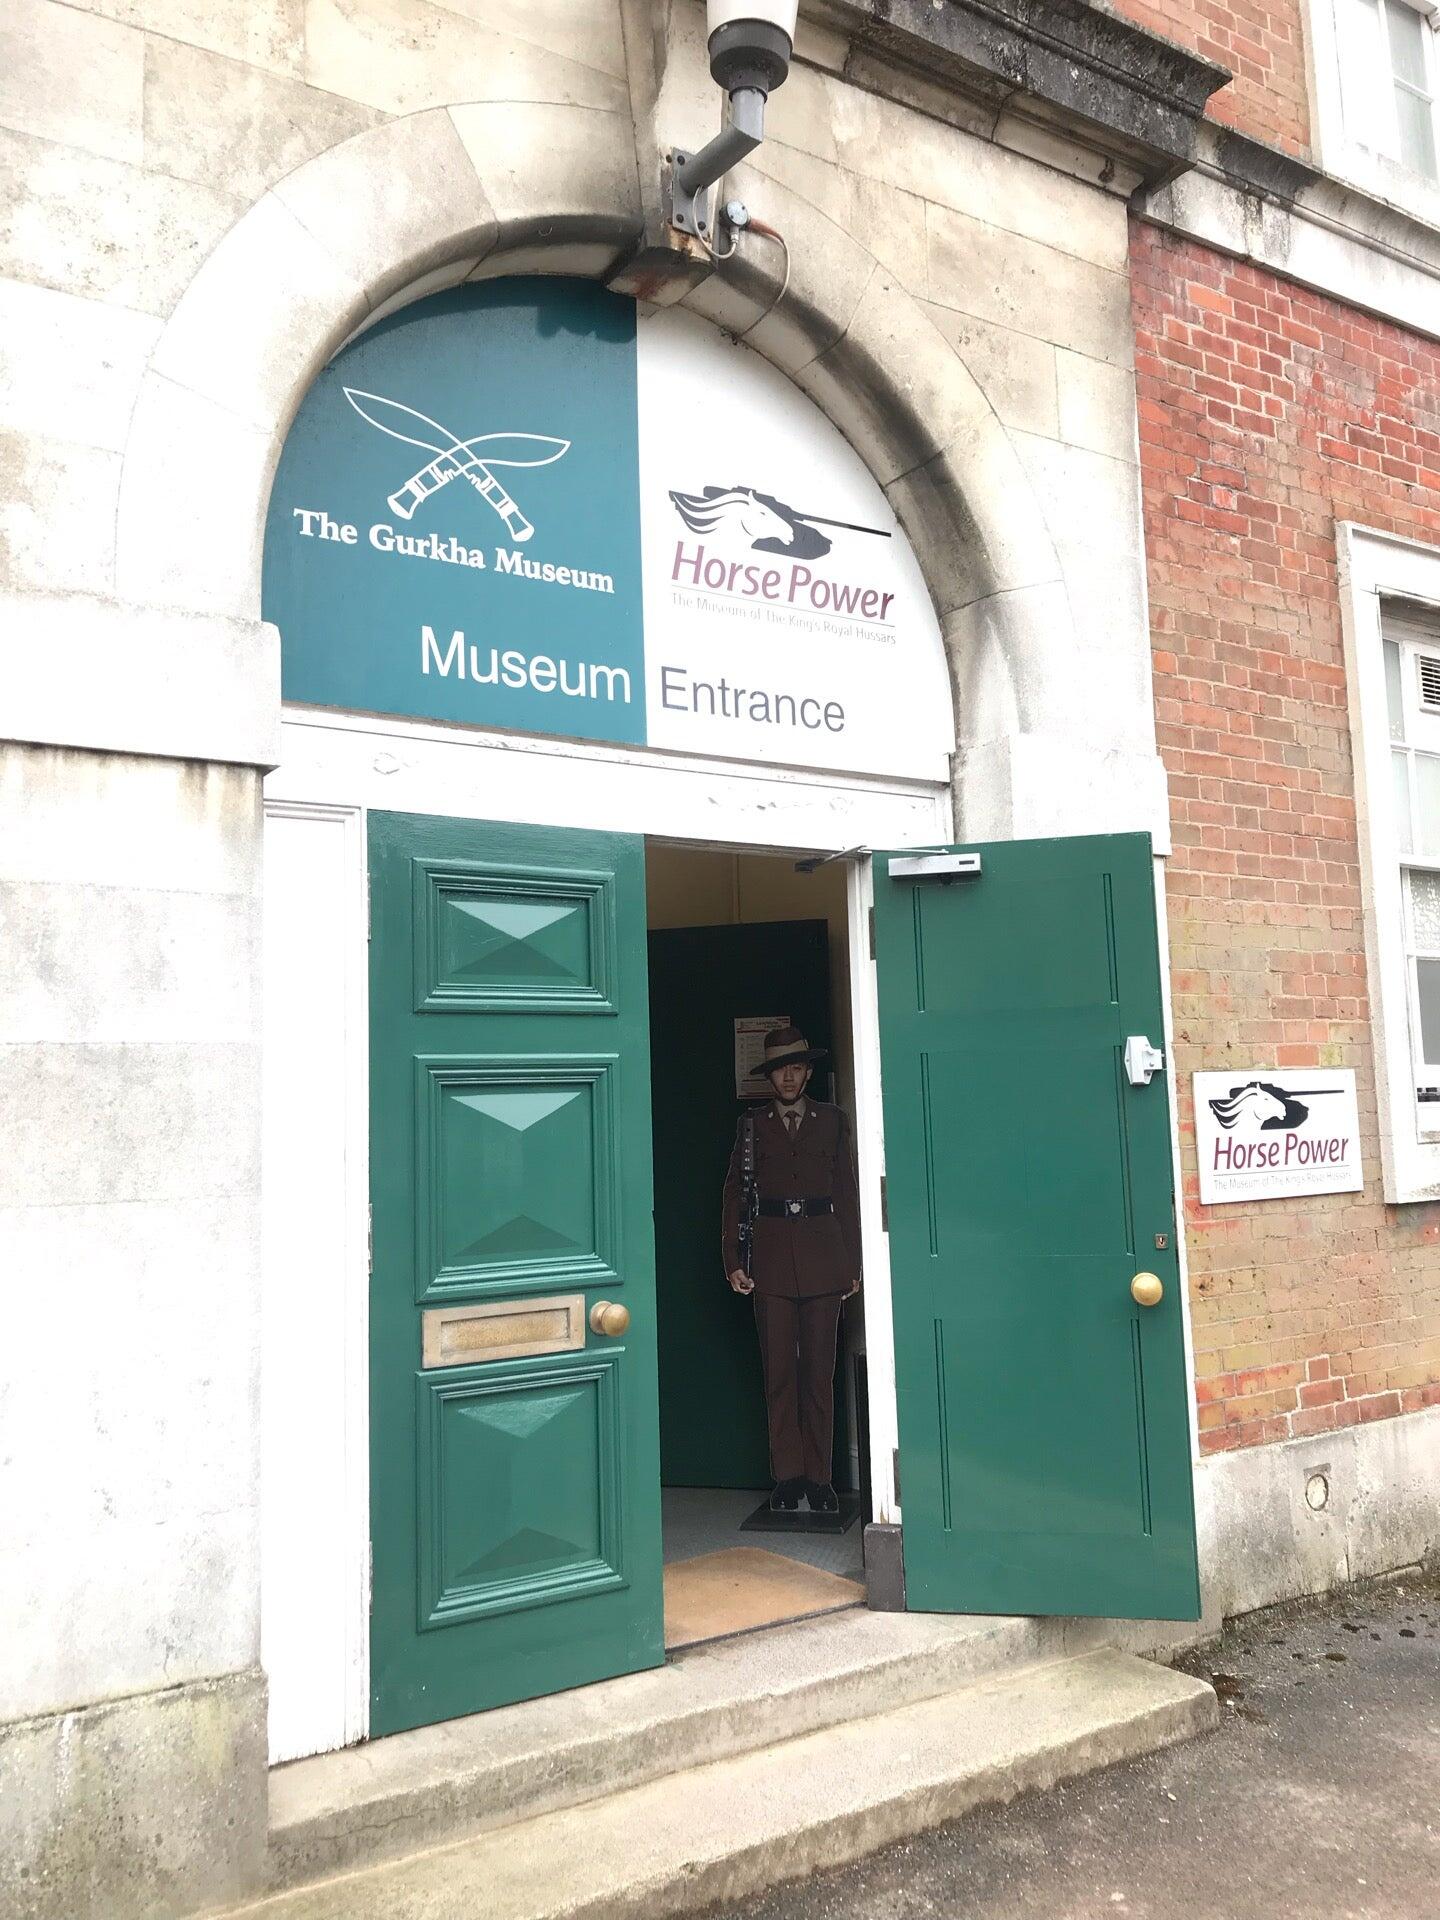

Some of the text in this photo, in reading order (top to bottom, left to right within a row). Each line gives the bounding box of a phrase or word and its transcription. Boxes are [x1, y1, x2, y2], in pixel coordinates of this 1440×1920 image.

[293, 507, 615, 594] The Gurkha Museum
[823, 620, 853, 637] Royal
[856, 626, 897, 645] Hussars
[421, 625, 846, 732] Museum Entrance
